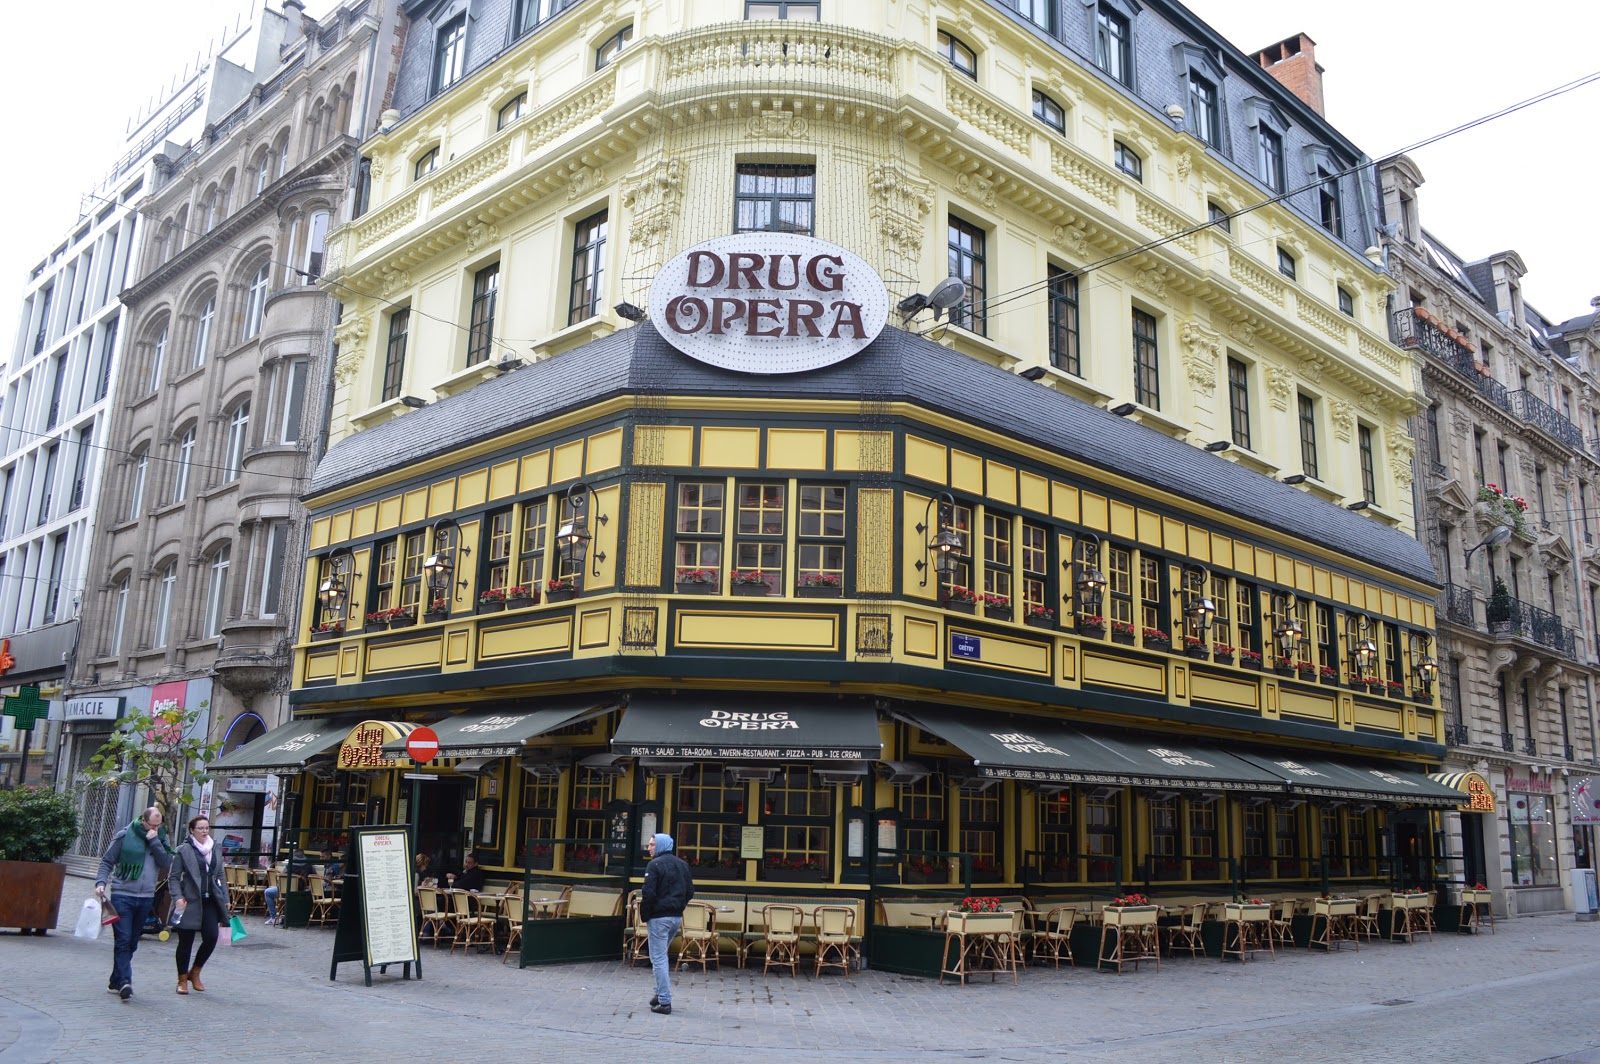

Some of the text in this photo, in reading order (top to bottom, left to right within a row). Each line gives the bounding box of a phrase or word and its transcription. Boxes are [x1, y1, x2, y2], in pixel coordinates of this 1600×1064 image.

[686, 250, 847, 292] DRUG
[665, 294, 871, 340] OPERA
[699, 718, 800, 730] OPERA
[710, 709, 790, 722] DRUG
[355, 724, 384, 746] drug
[631, 747, 862, 759] PASTA SALAD TEA-ROOM TAVERN-RESTAURANT PIZZA PUB ICE CREAM
